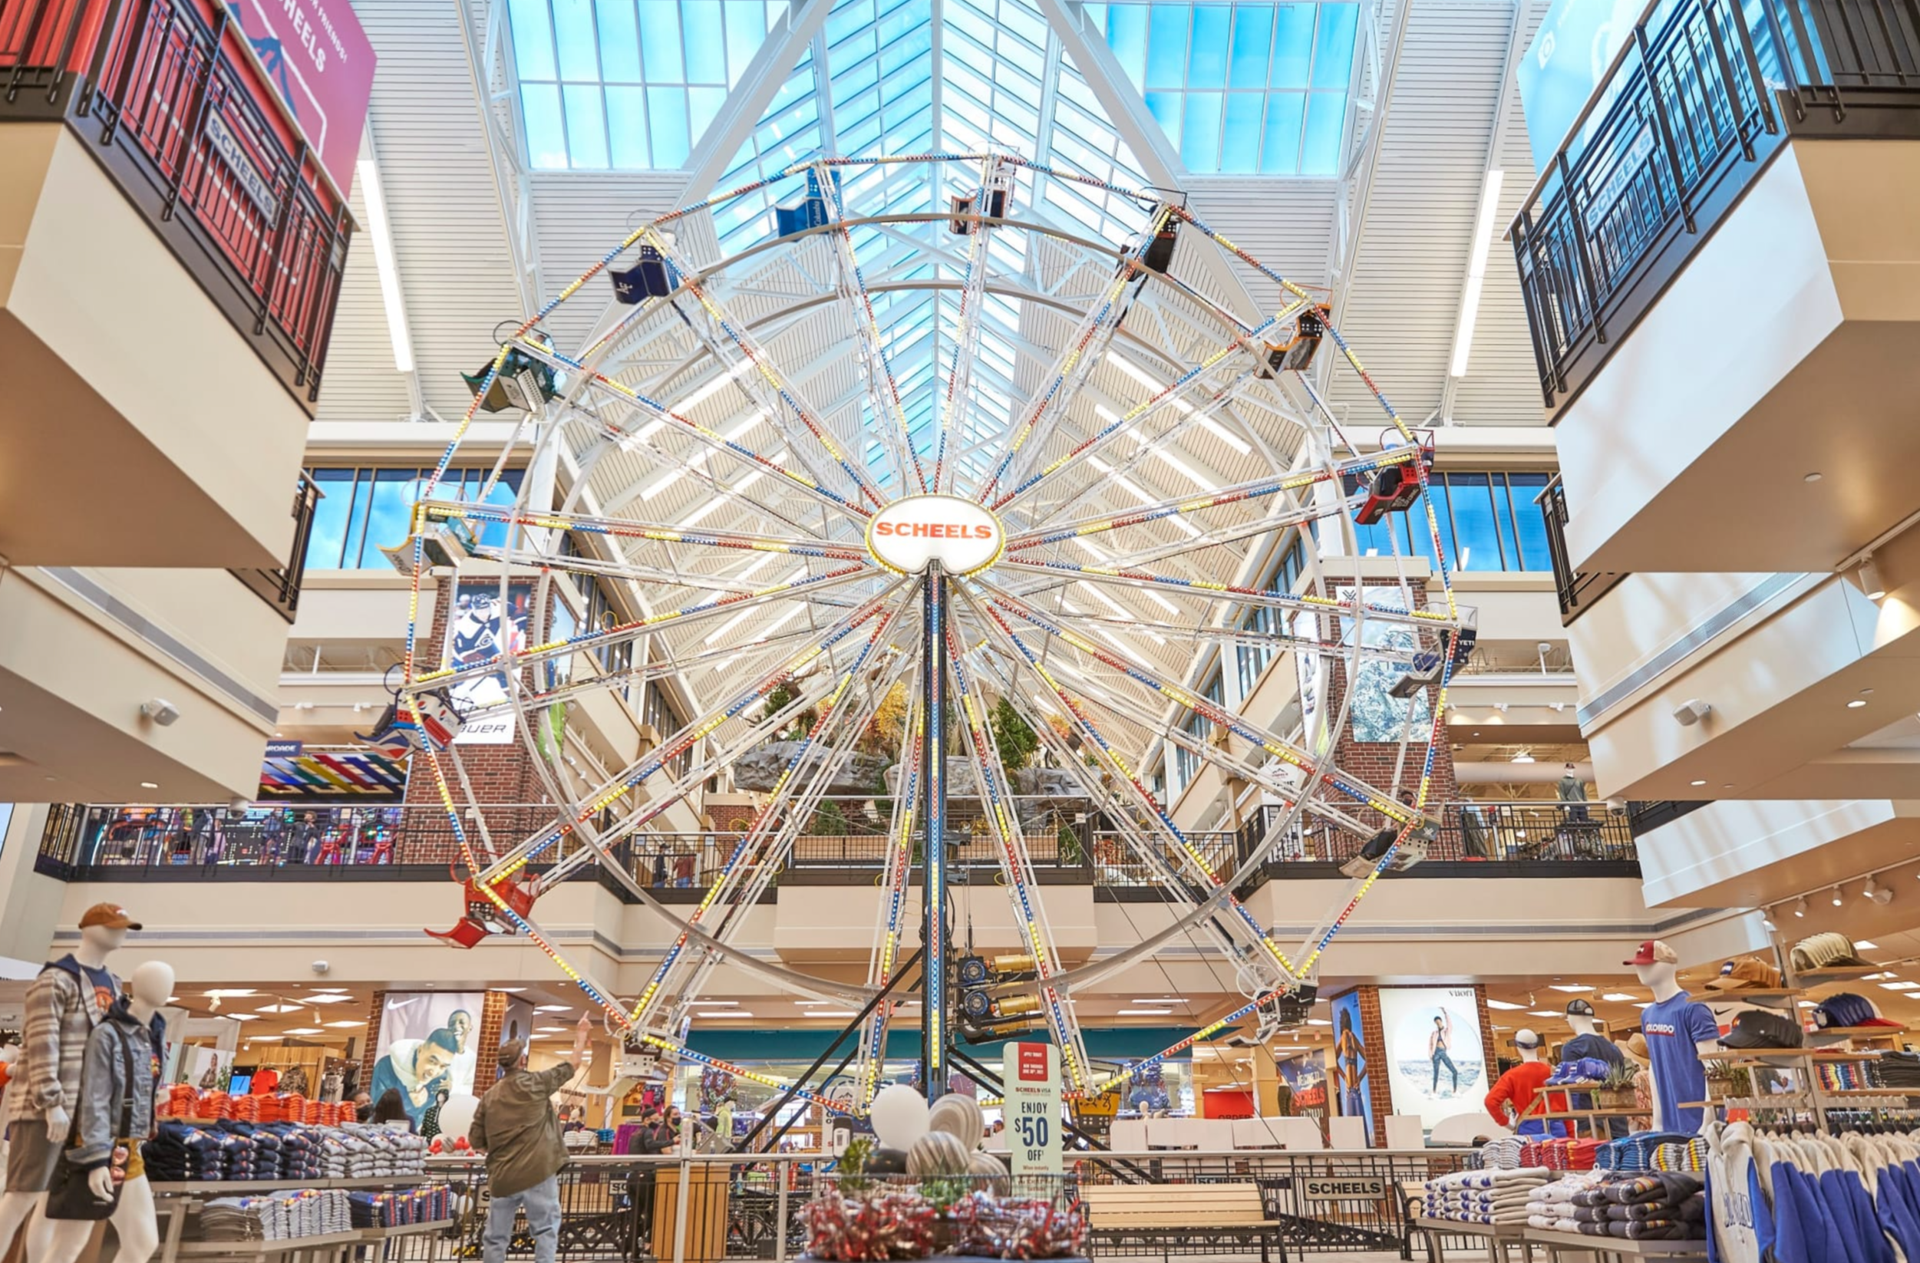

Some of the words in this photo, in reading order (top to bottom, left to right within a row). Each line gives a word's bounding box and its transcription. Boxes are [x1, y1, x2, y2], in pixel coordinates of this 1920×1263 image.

[277, 0, 326, 73] HEELS
[210, 117, 275, 215] SCHEELS
[1588, 133, 1651, 227] SCHEELS
[876, 521, 992, 539] SCHEELS
[1021, 1101, 1048, 1114] ENJOY
[1014, 1116, 1049, 1147] $50
[1308, 1182, 1381, 1194] SCHEELS
